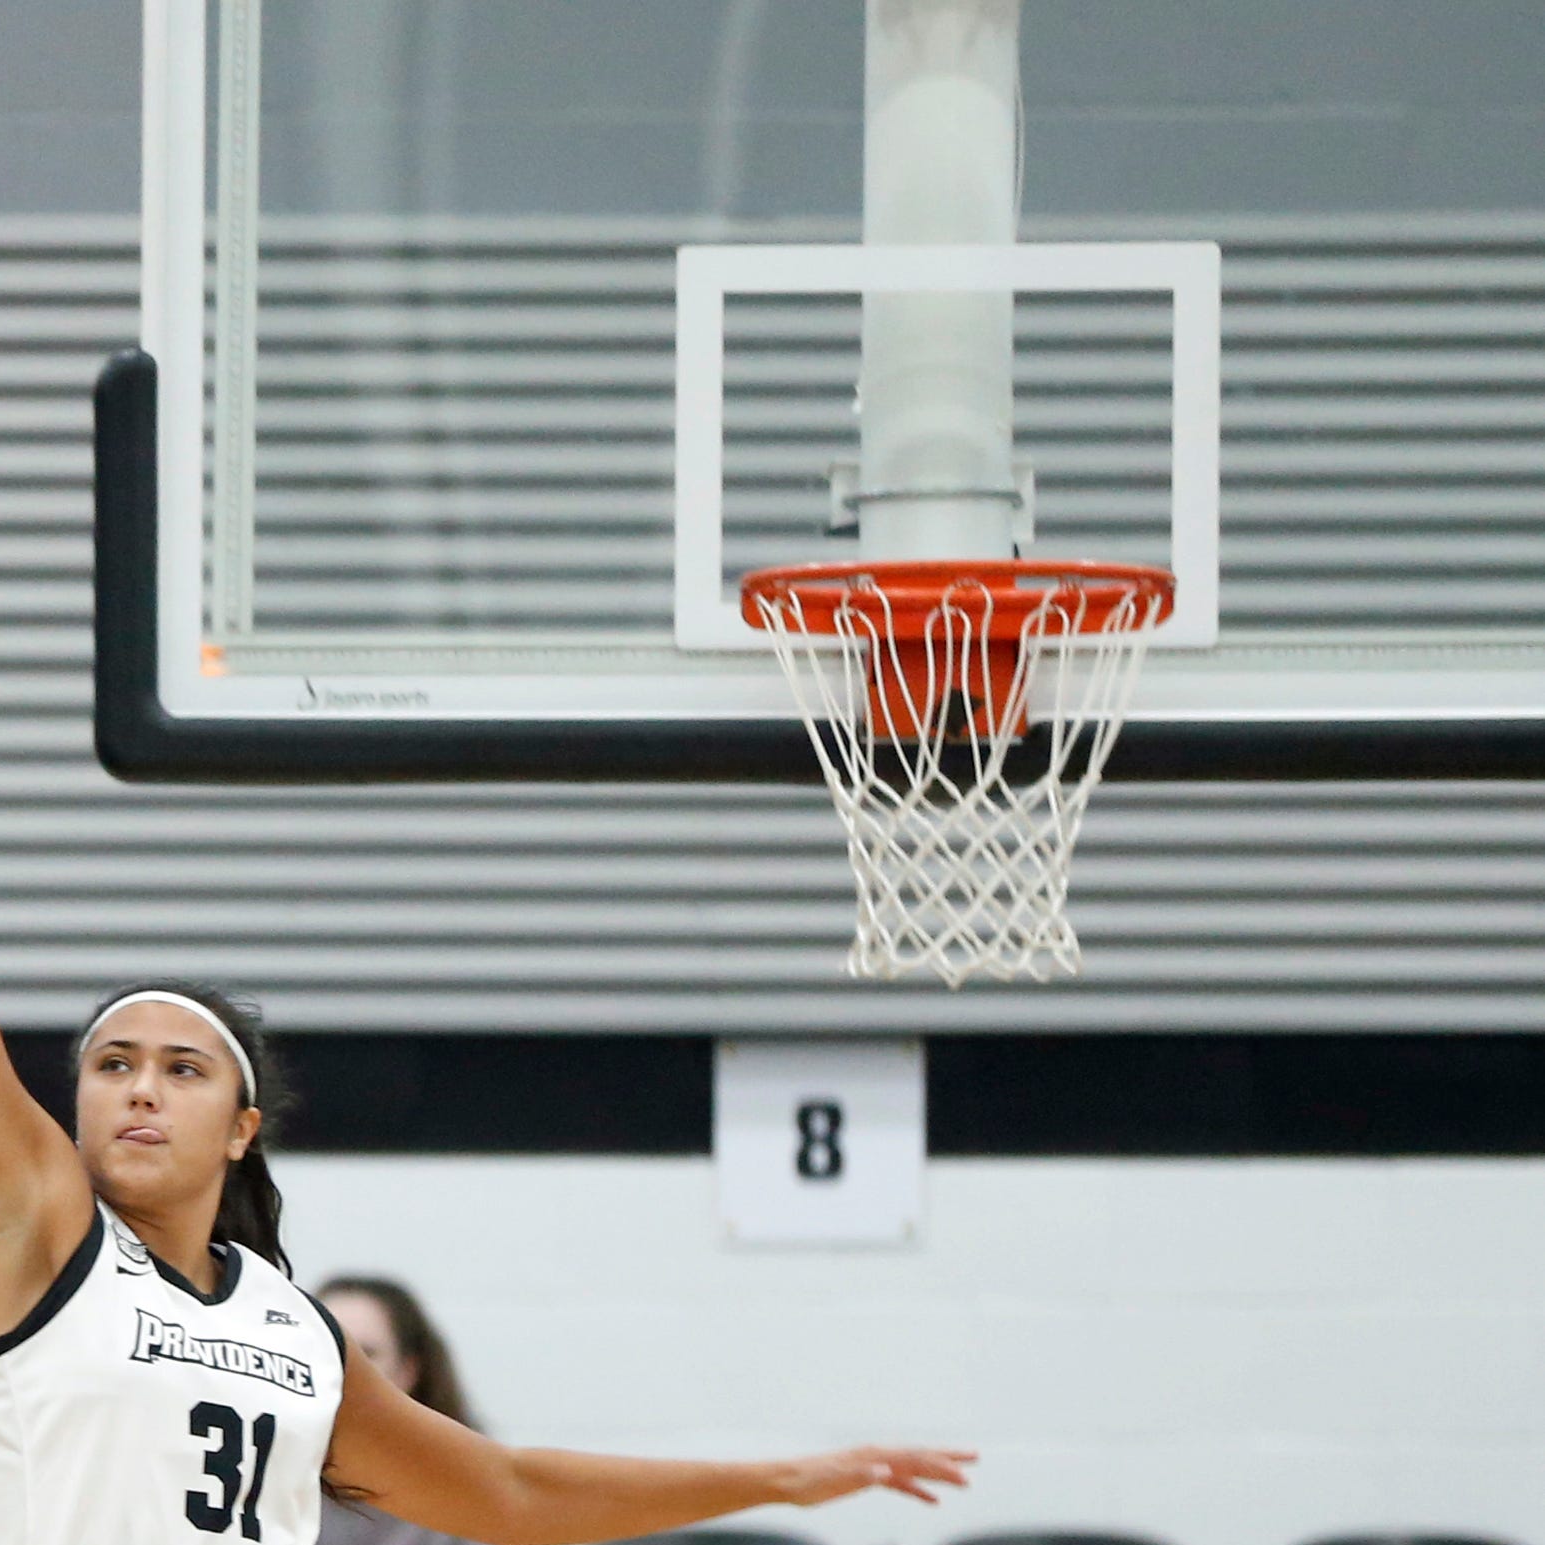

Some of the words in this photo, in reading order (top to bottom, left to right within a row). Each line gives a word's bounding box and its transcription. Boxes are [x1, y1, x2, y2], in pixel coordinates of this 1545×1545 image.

[796, 1098, 843, 1180] 8
[128, 1306, 316, 1398] PROVIDENCE
[185, 1401, 276, 1542] 31
